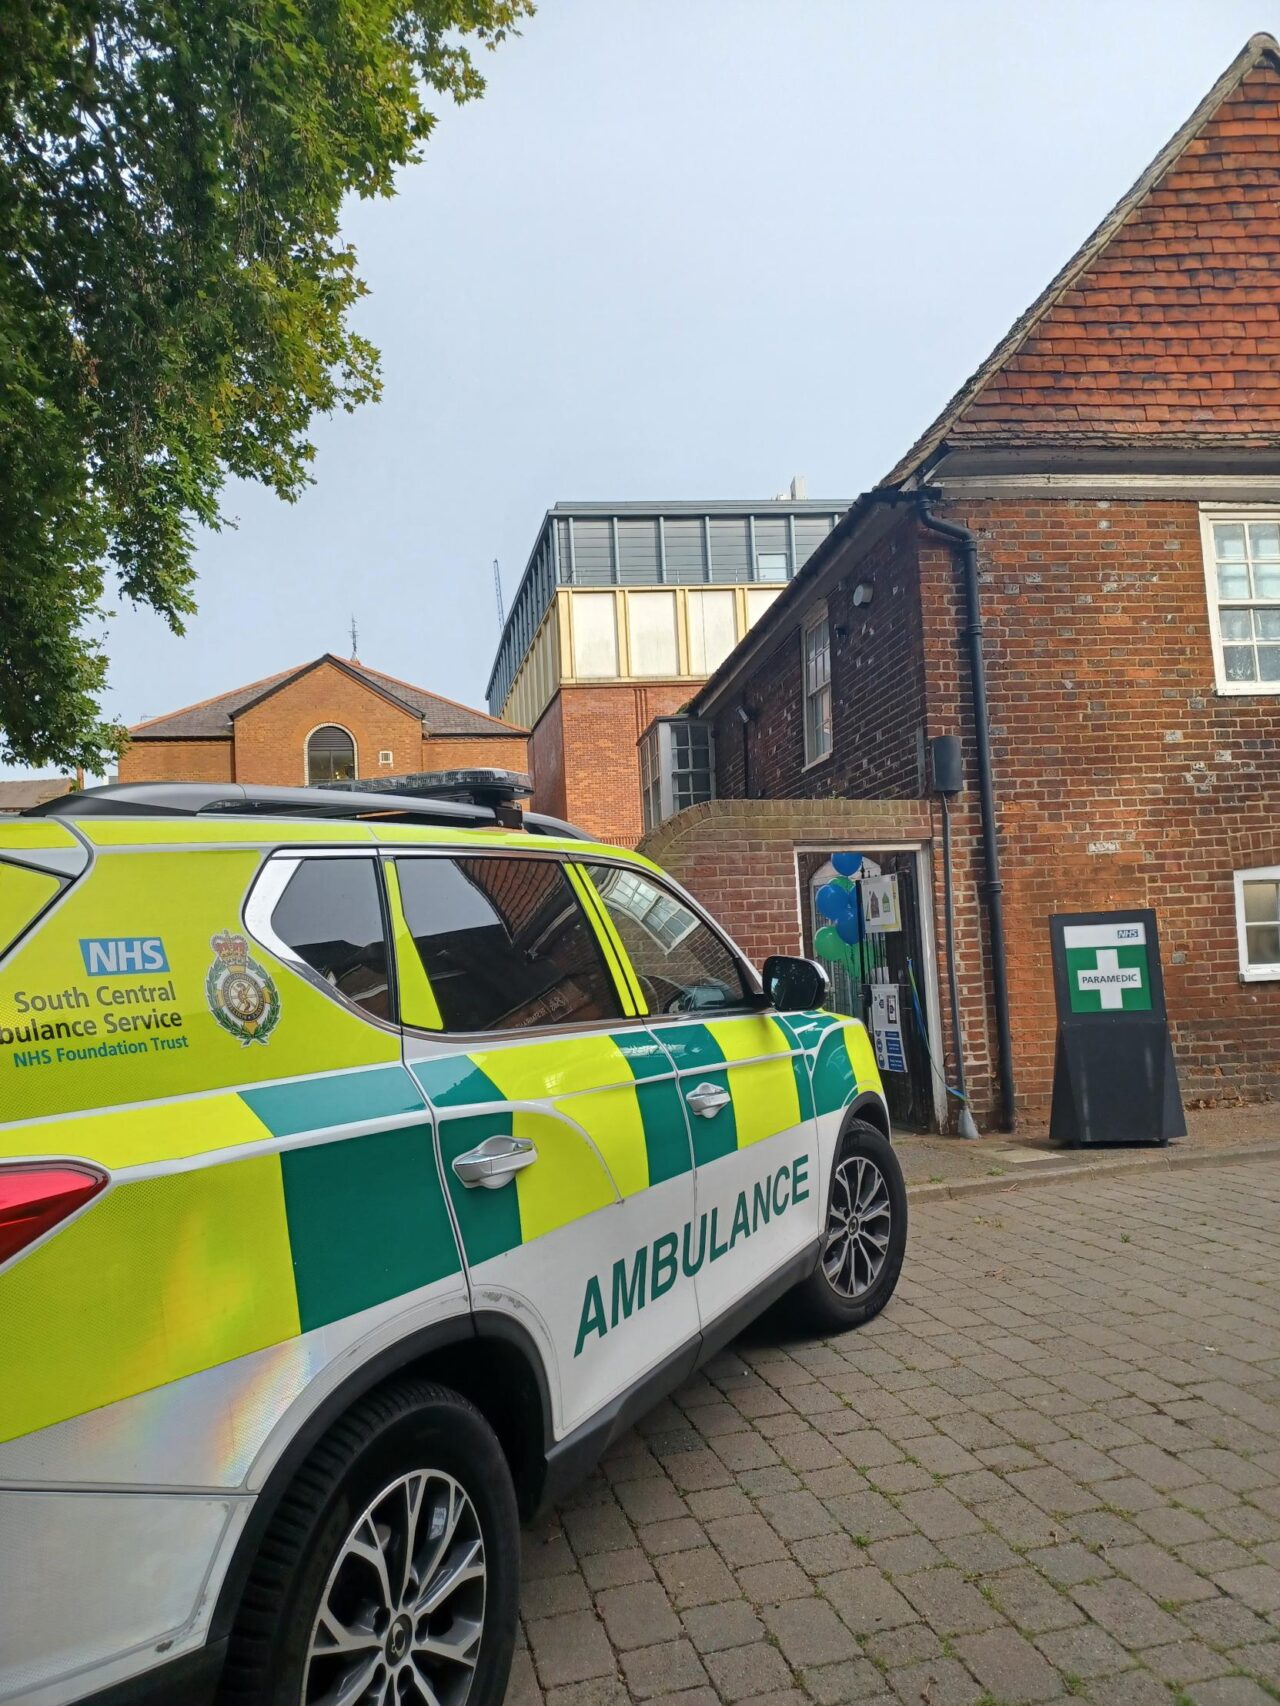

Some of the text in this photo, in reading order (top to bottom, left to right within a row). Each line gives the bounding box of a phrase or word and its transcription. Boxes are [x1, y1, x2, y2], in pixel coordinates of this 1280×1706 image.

[1117, 929, 1139, 938] NHS
[88, 939, 165, 972] NHS
[1082, 973, 1137, 984] PARAMEDIC
[14, 980, 177, 1013] South Central
[105, 1008, 182, 1034] Service
[13, 1035, 189, 1067] NHS Foundation Trust
[573, 1153, 810, 1359] AMBULANCE
